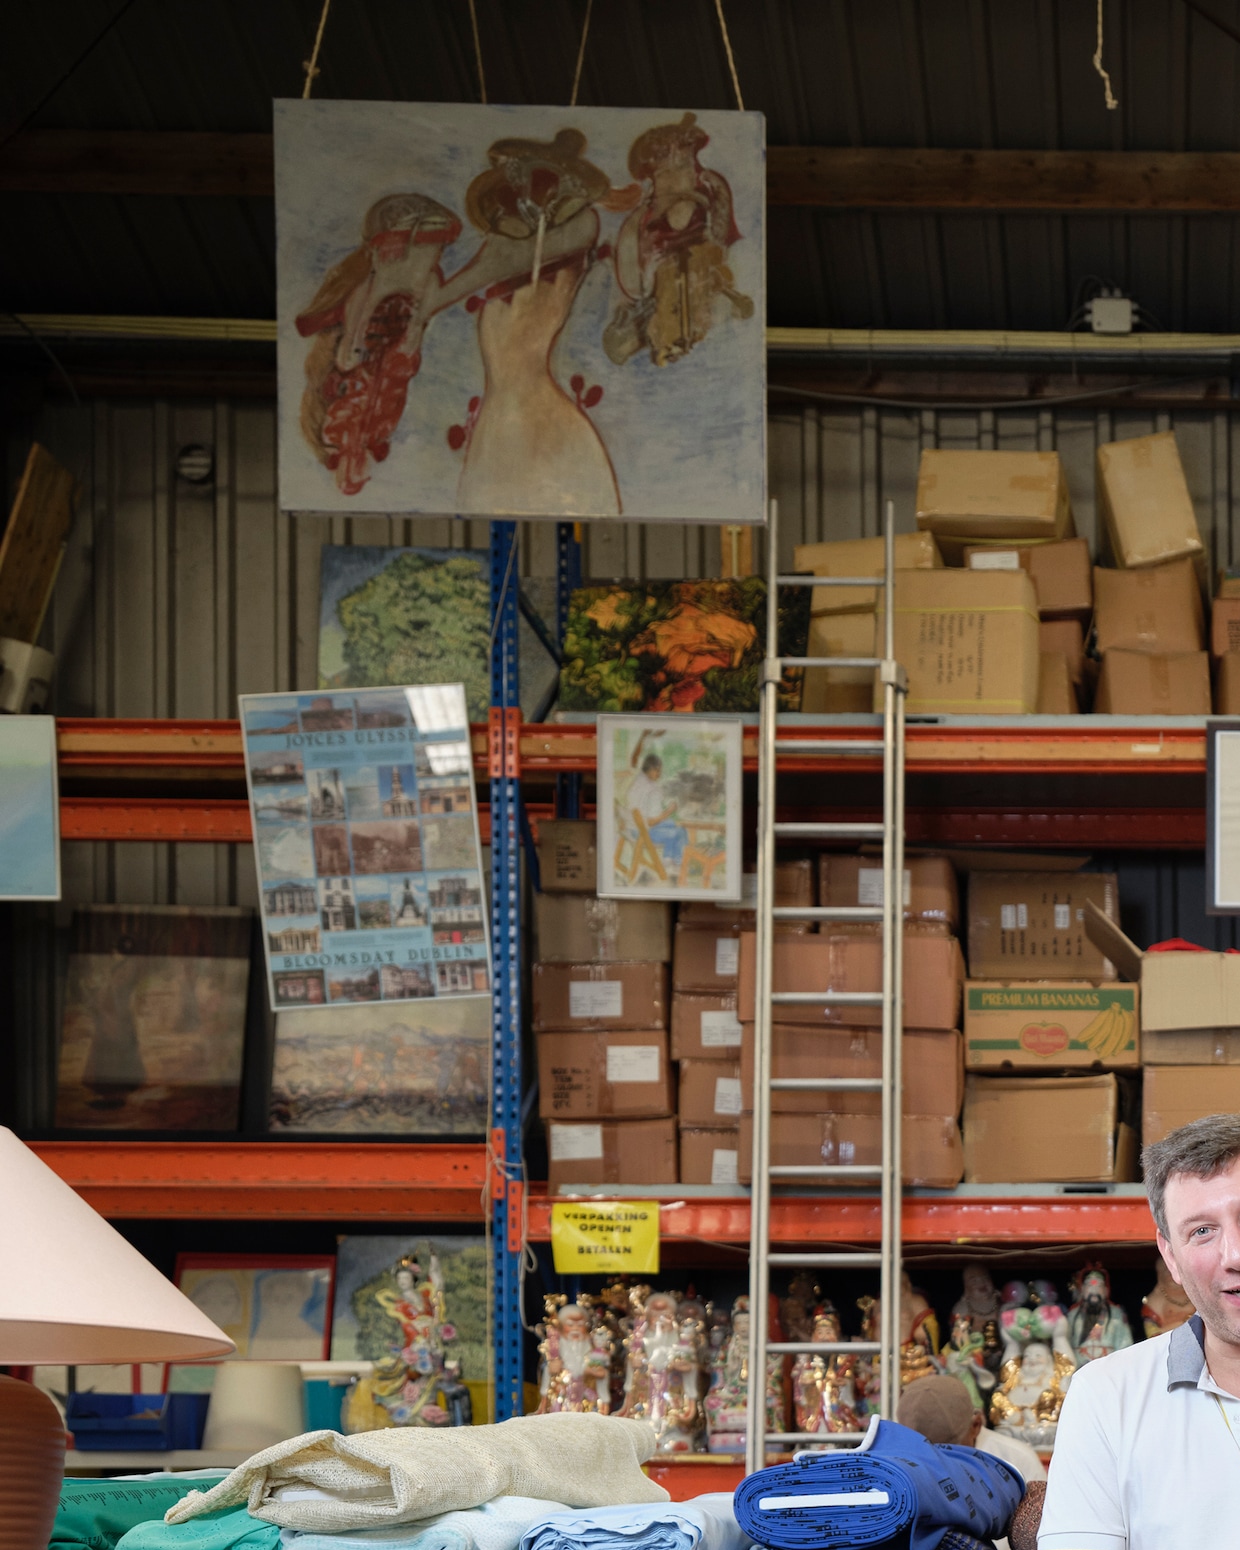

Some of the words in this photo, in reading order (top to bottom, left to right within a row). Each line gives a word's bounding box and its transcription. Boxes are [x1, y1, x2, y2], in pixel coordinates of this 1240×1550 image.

[283, 950, 396, 968] BLOOMSDAY
[408, 943, 474, 961] DUBLIN
[981, 992, 1040, 1006] PREMIUM
[1041, 992, 1100, 1006] BANANAS
[563, 1212, 649, 1221] VERPAKKING
[579, 1223, 632, 1233] OPENEN
[577, 1245, 632, 1254] BETALEN
